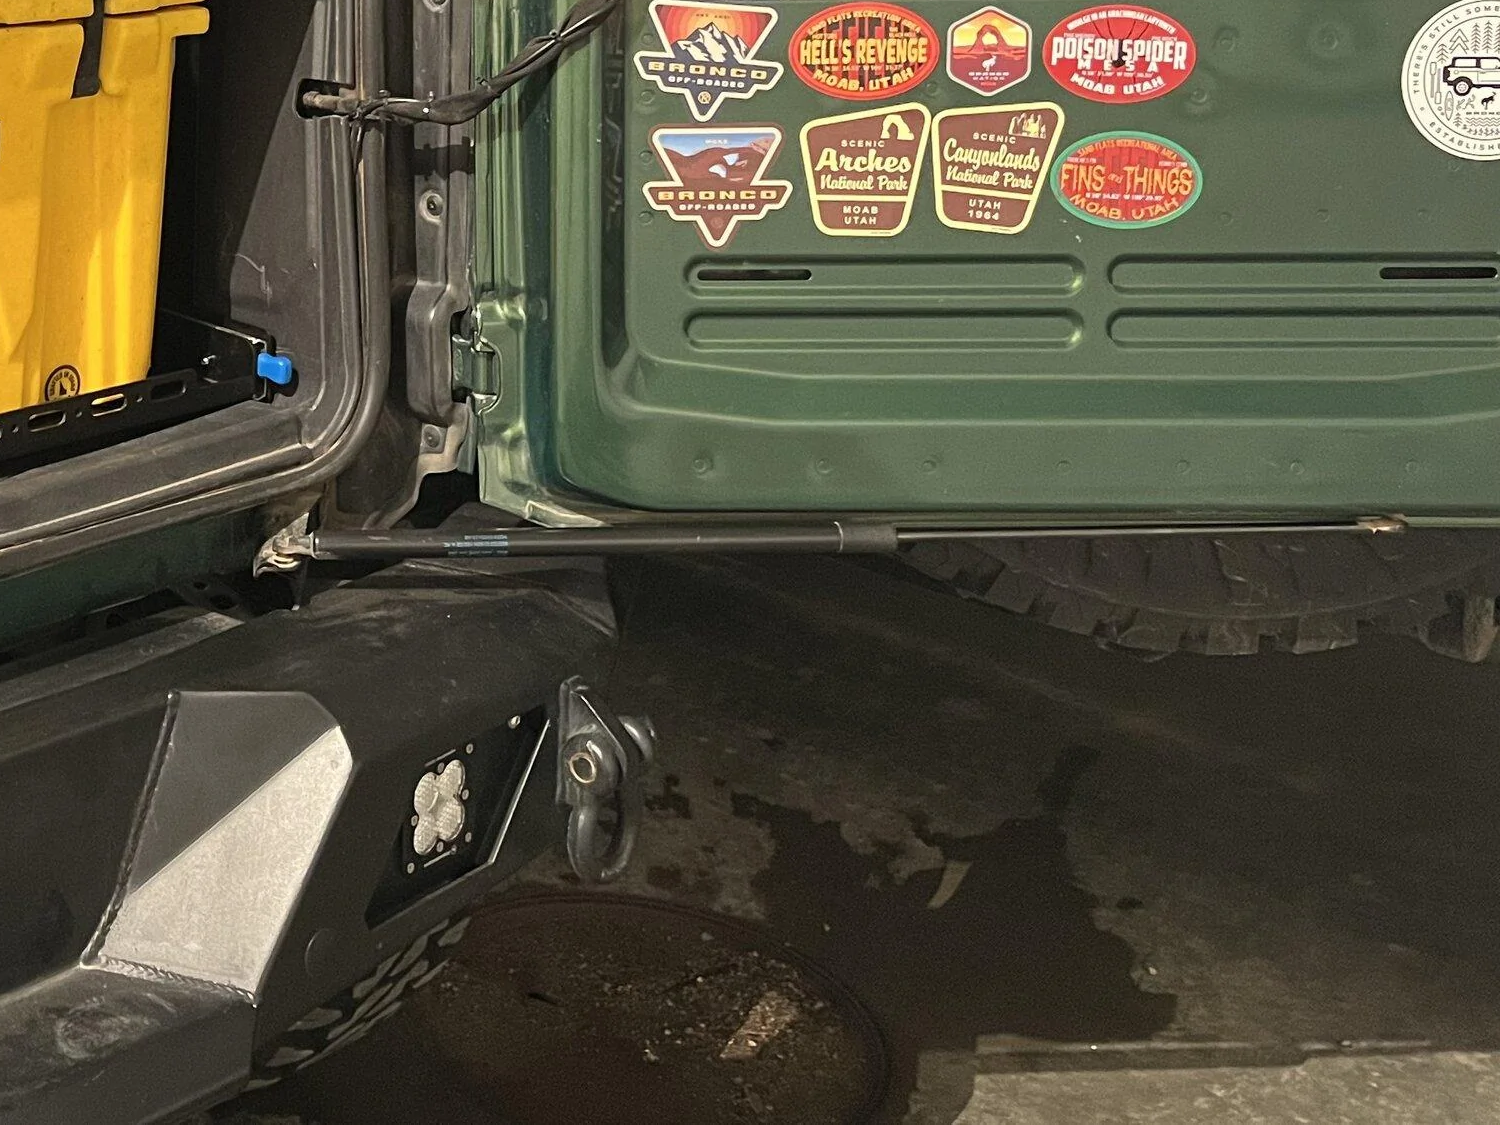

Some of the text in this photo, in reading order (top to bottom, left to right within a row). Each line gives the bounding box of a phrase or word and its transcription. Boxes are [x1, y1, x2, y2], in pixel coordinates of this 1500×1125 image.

[800, 37, 928, 65] HELL'S REVENGE
[1051, 36, 1187, 70] POISON SPIDER
[1412, 44, 1428, 94] THERE'S
[1429, 14, 1460, 39] STILL
[648, 61, 767, 80] BRONCO
[1077, 59, 1159, 72] MESA
[668, 75, 745, 88] OFF-ROADEO
[869, 67, 914, 91] UTAH
[1070, 73, 1115, 94] MOAB
[1123, 76, 1164, 94] UTAH
[972, 132, 1017, 144] SCENIC
[815, 148, 911, 173] Arches
[943, 137, 1040, 172] Canyonlands
[820, 174, 908, 191] National Park
[946, 165, 1034, 189] National Park
[1060, 163, 1106, 192] FINS
[1122, 164, 1193, 196] THINGS
[658, 190, 777, 201] BRONCO
[968, 199, 1002, 210] UTAH
[679, 203, 756, 211] OFF-ROADEO
[843, 206, 878, 214] MOAB
[967, 210, 1000, 221] 1964
[1131, 197, 1180, 220] UTAH
[844, 216, 877, 224] UTAH
